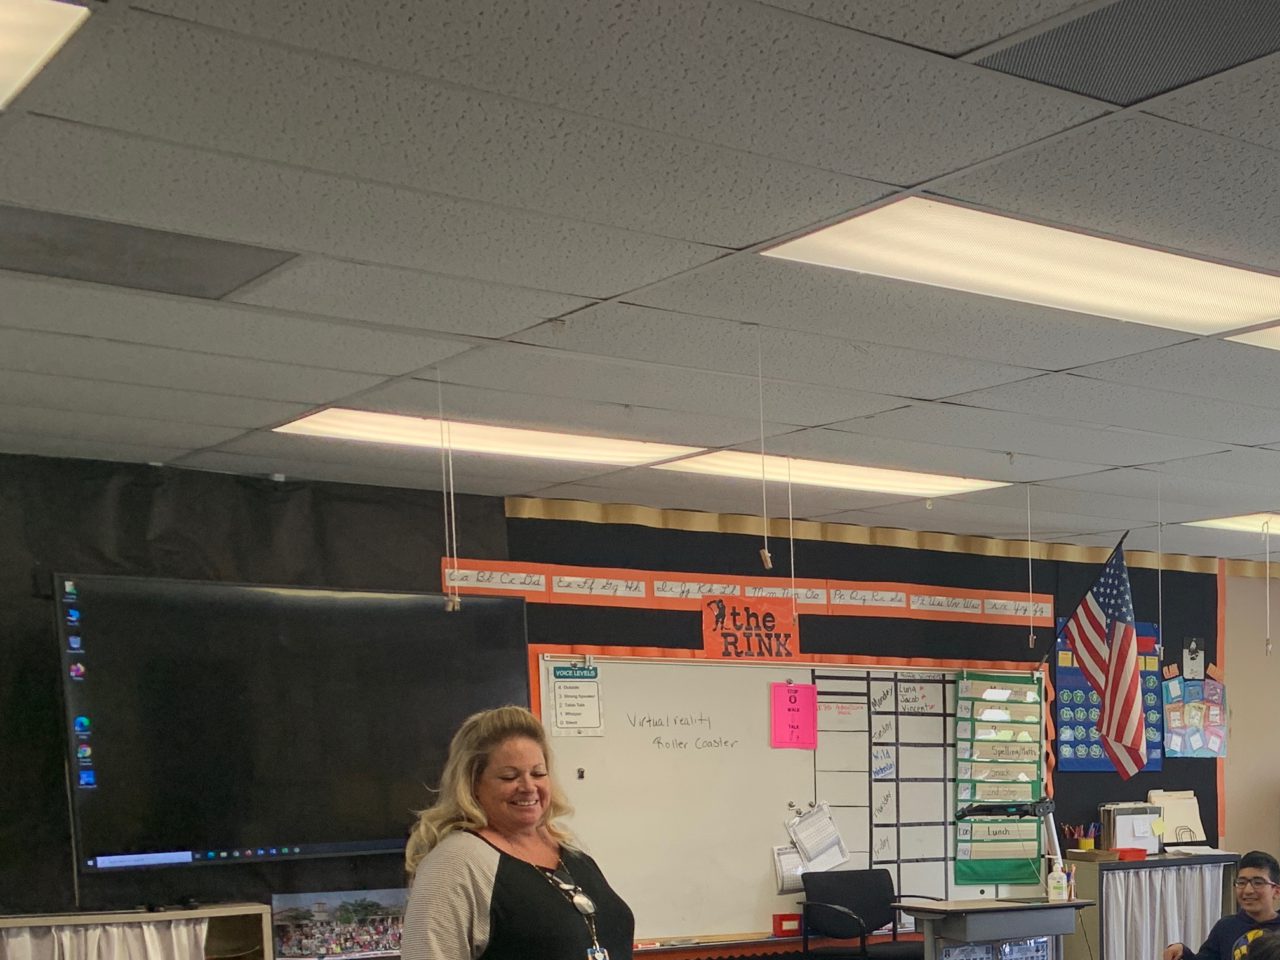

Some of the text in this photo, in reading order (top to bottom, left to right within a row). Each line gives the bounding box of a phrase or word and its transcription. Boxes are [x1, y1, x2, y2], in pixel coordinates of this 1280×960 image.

[730, 606, 776, 632] the
[721, 632, 793, 657] RINK
[871, 685, 893, 711] Monday
[900, 695, 919, 703] Jacob
[902, 703, 928, 712] Vincent
[627, 711, 712, 730] Virtual reality
[652, 736, 739, 750] Roller Coaster
[987, 826, 1010, 836] Lunch
